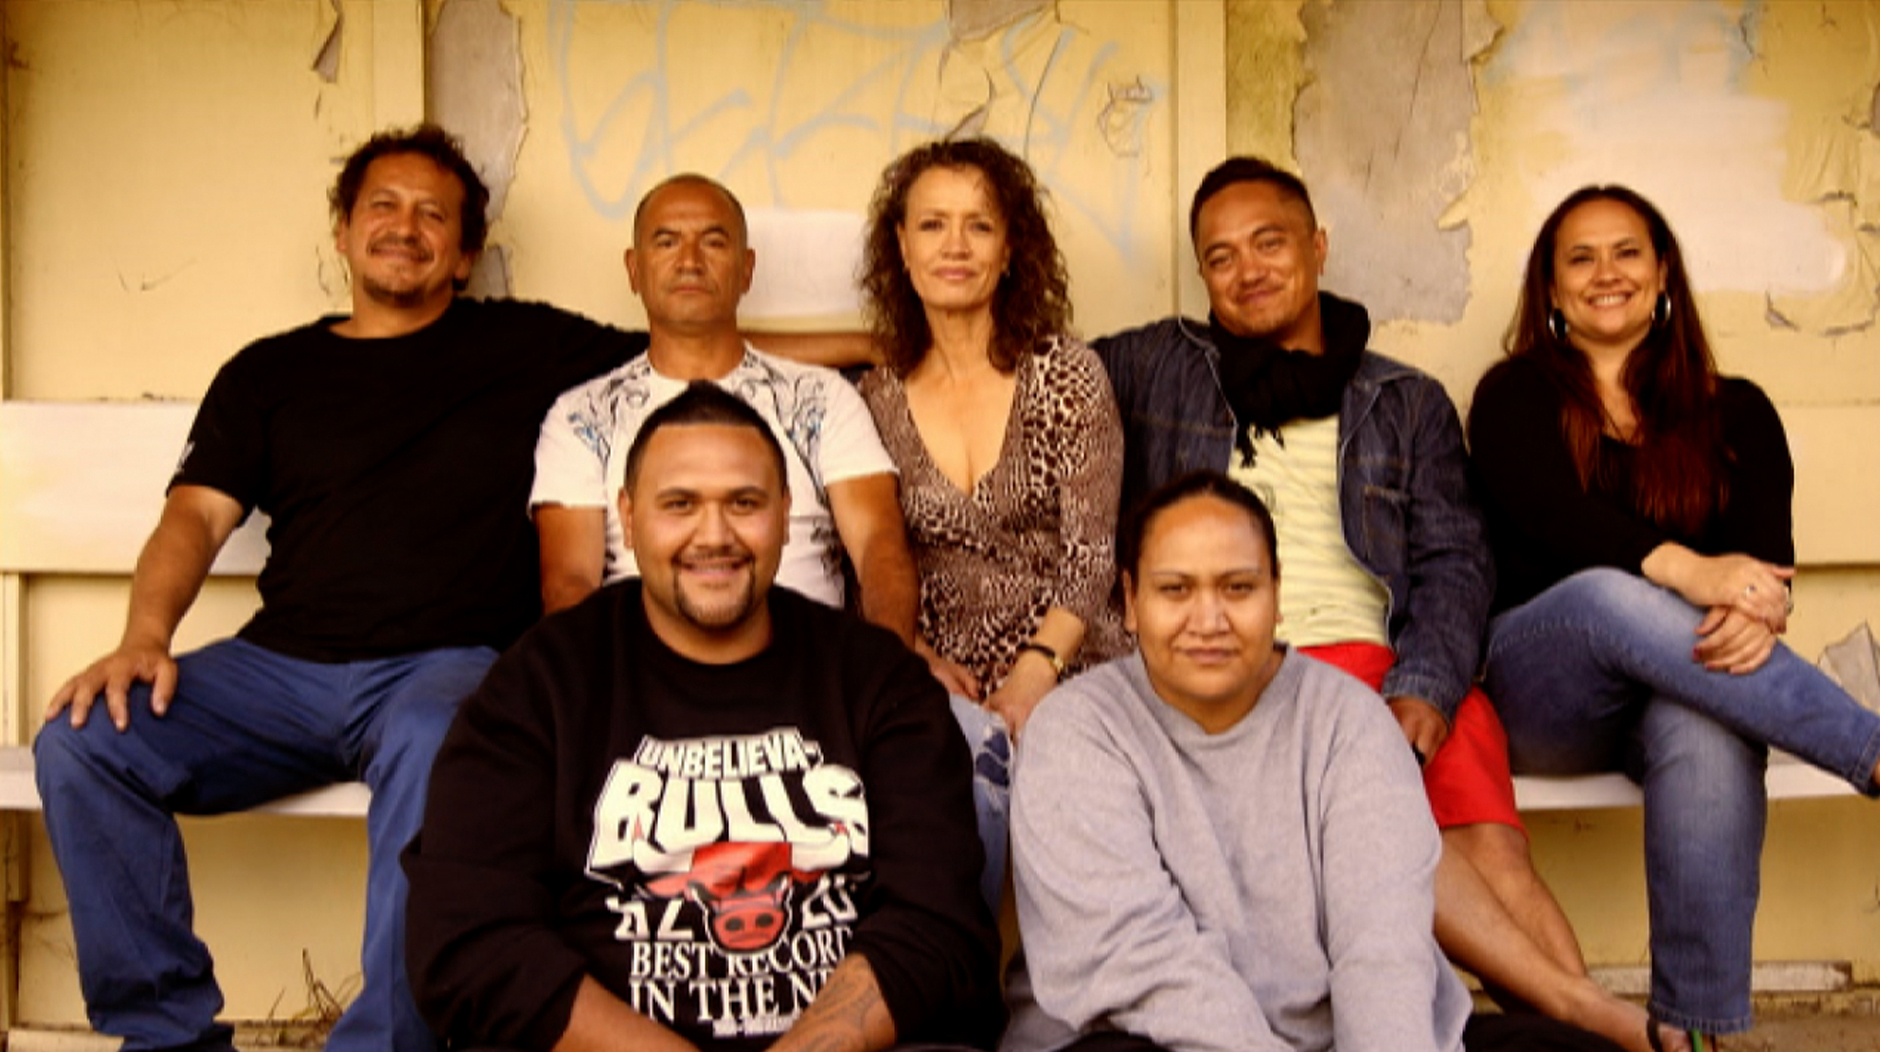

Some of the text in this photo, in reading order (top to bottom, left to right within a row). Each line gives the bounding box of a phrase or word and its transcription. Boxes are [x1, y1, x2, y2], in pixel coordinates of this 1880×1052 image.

[588, 760, 869, 869] BULLS
[631, 940, 713, 980] BEST
[629, 975, 677, 1023] IN
[688, 974, 781, 1022] THE
